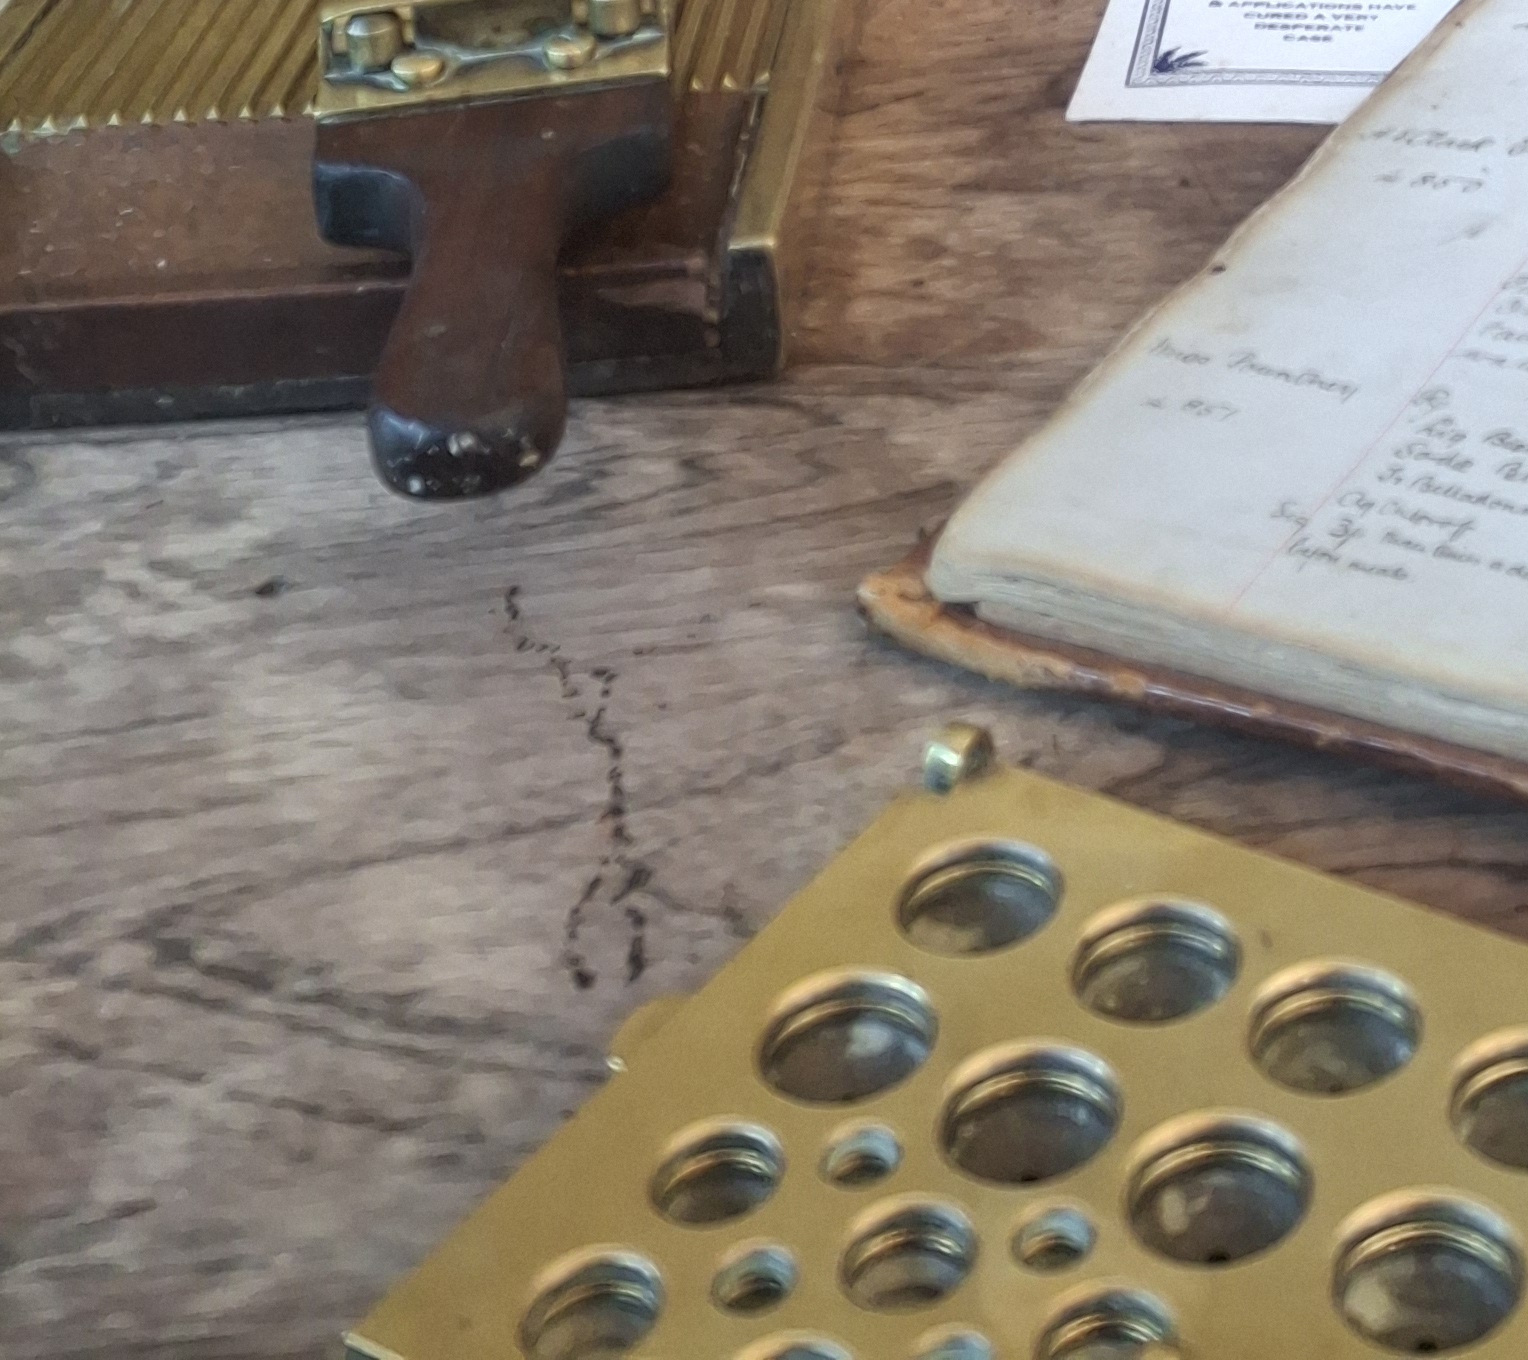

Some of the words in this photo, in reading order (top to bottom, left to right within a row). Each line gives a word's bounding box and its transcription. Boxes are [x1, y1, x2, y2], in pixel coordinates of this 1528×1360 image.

[1228, 0, 1364, 11] APPLICATIONS
[1368, 3, 1417, 11] HAVE
[1243, 12, 1308, 21] CURED
[1314, 13, 1326, 21] A
[1331, 13, 1379, 22] VERY
[1254, 22, 1365, 31] DESPERATE
[1282, 34, 1333, 43] CASE
